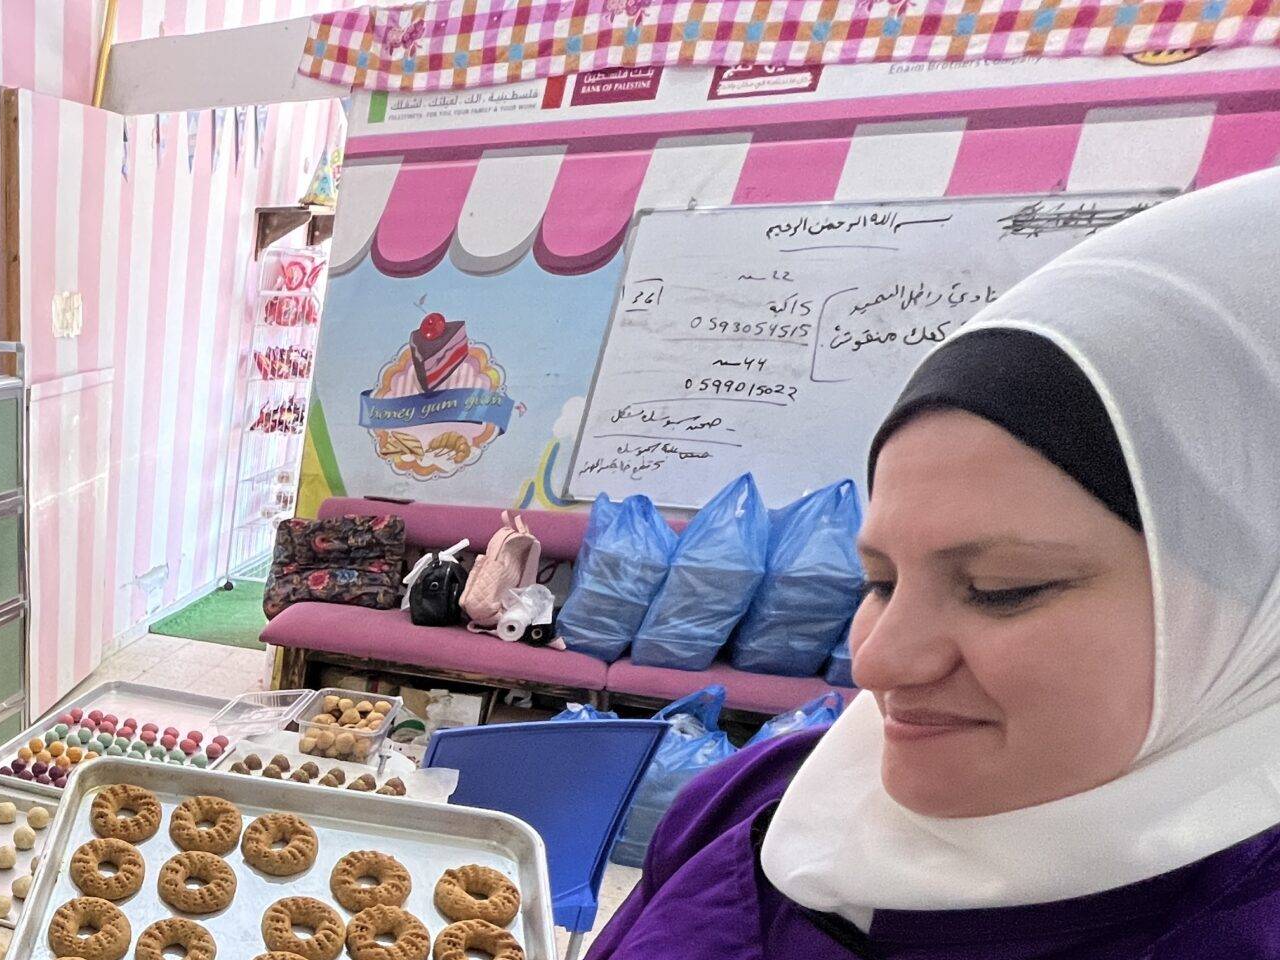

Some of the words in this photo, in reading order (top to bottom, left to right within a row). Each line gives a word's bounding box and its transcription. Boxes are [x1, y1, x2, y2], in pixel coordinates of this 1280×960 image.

[583, 69, 628, 84] فلسطين
[629, 66, 655, 78] بنك
[581, 84, 601, 94] BANK
[602, 83, 612, 92] OF
[613, 80, 652, 91] PALESTINE
